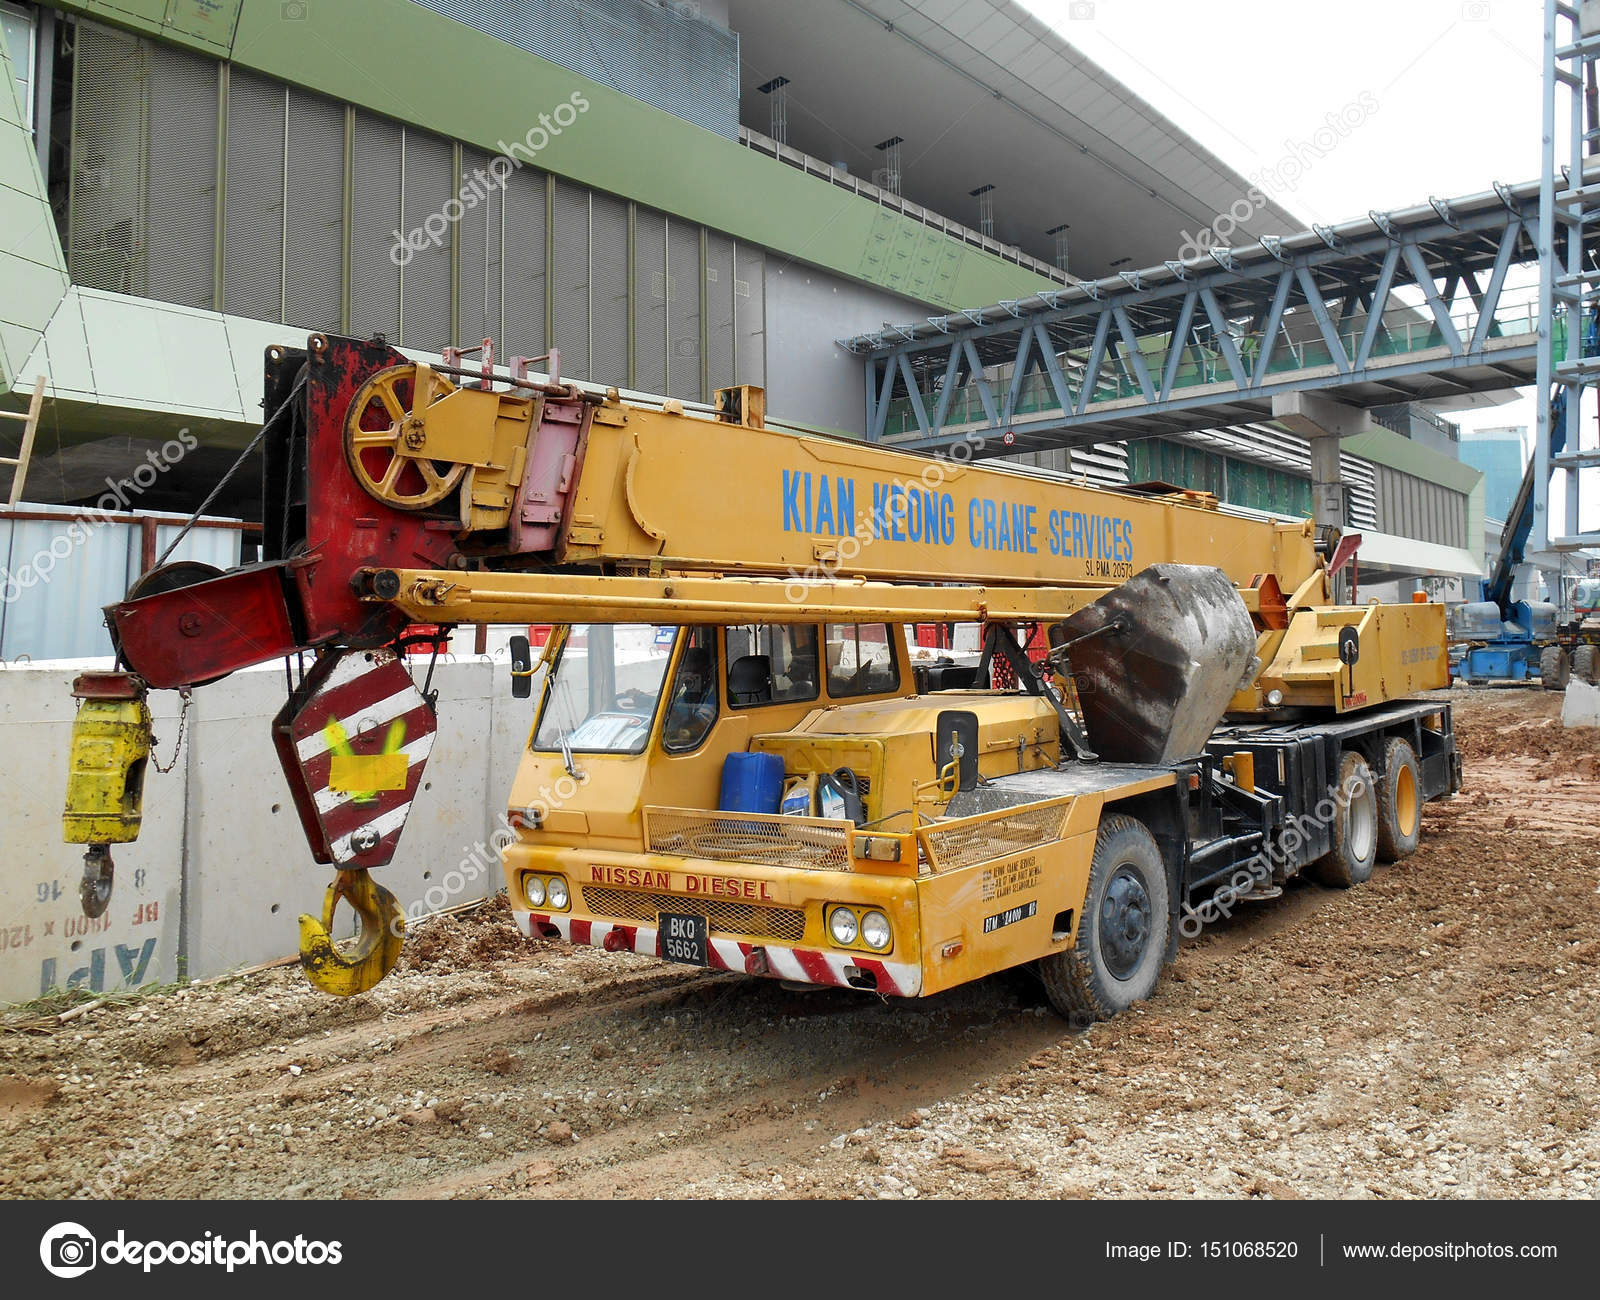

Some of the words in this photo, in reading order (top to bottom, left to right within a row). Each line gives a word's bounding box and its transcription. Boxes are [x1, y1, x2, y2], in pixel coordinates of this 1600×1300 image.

[783, 469, 855, 537] KIAN
[873, 482, 955, 545] KEONG
[968, 497, 1038, 555] CRANE
[1049, 509, 1133, 563] SERVICES
[1085, 559, 1094, 577] SL
[1096, 560, 1110, 577] PMA
[1112, 562, 1133, 579] 20573
[591, 866, 670, 889] NISSAN
[686, 875, 772, 900] DIESEL
[132, 901, 159, 926] BF
[670, 917, 695, 939] BKQ
[666, 938, 700, 961] 5662
